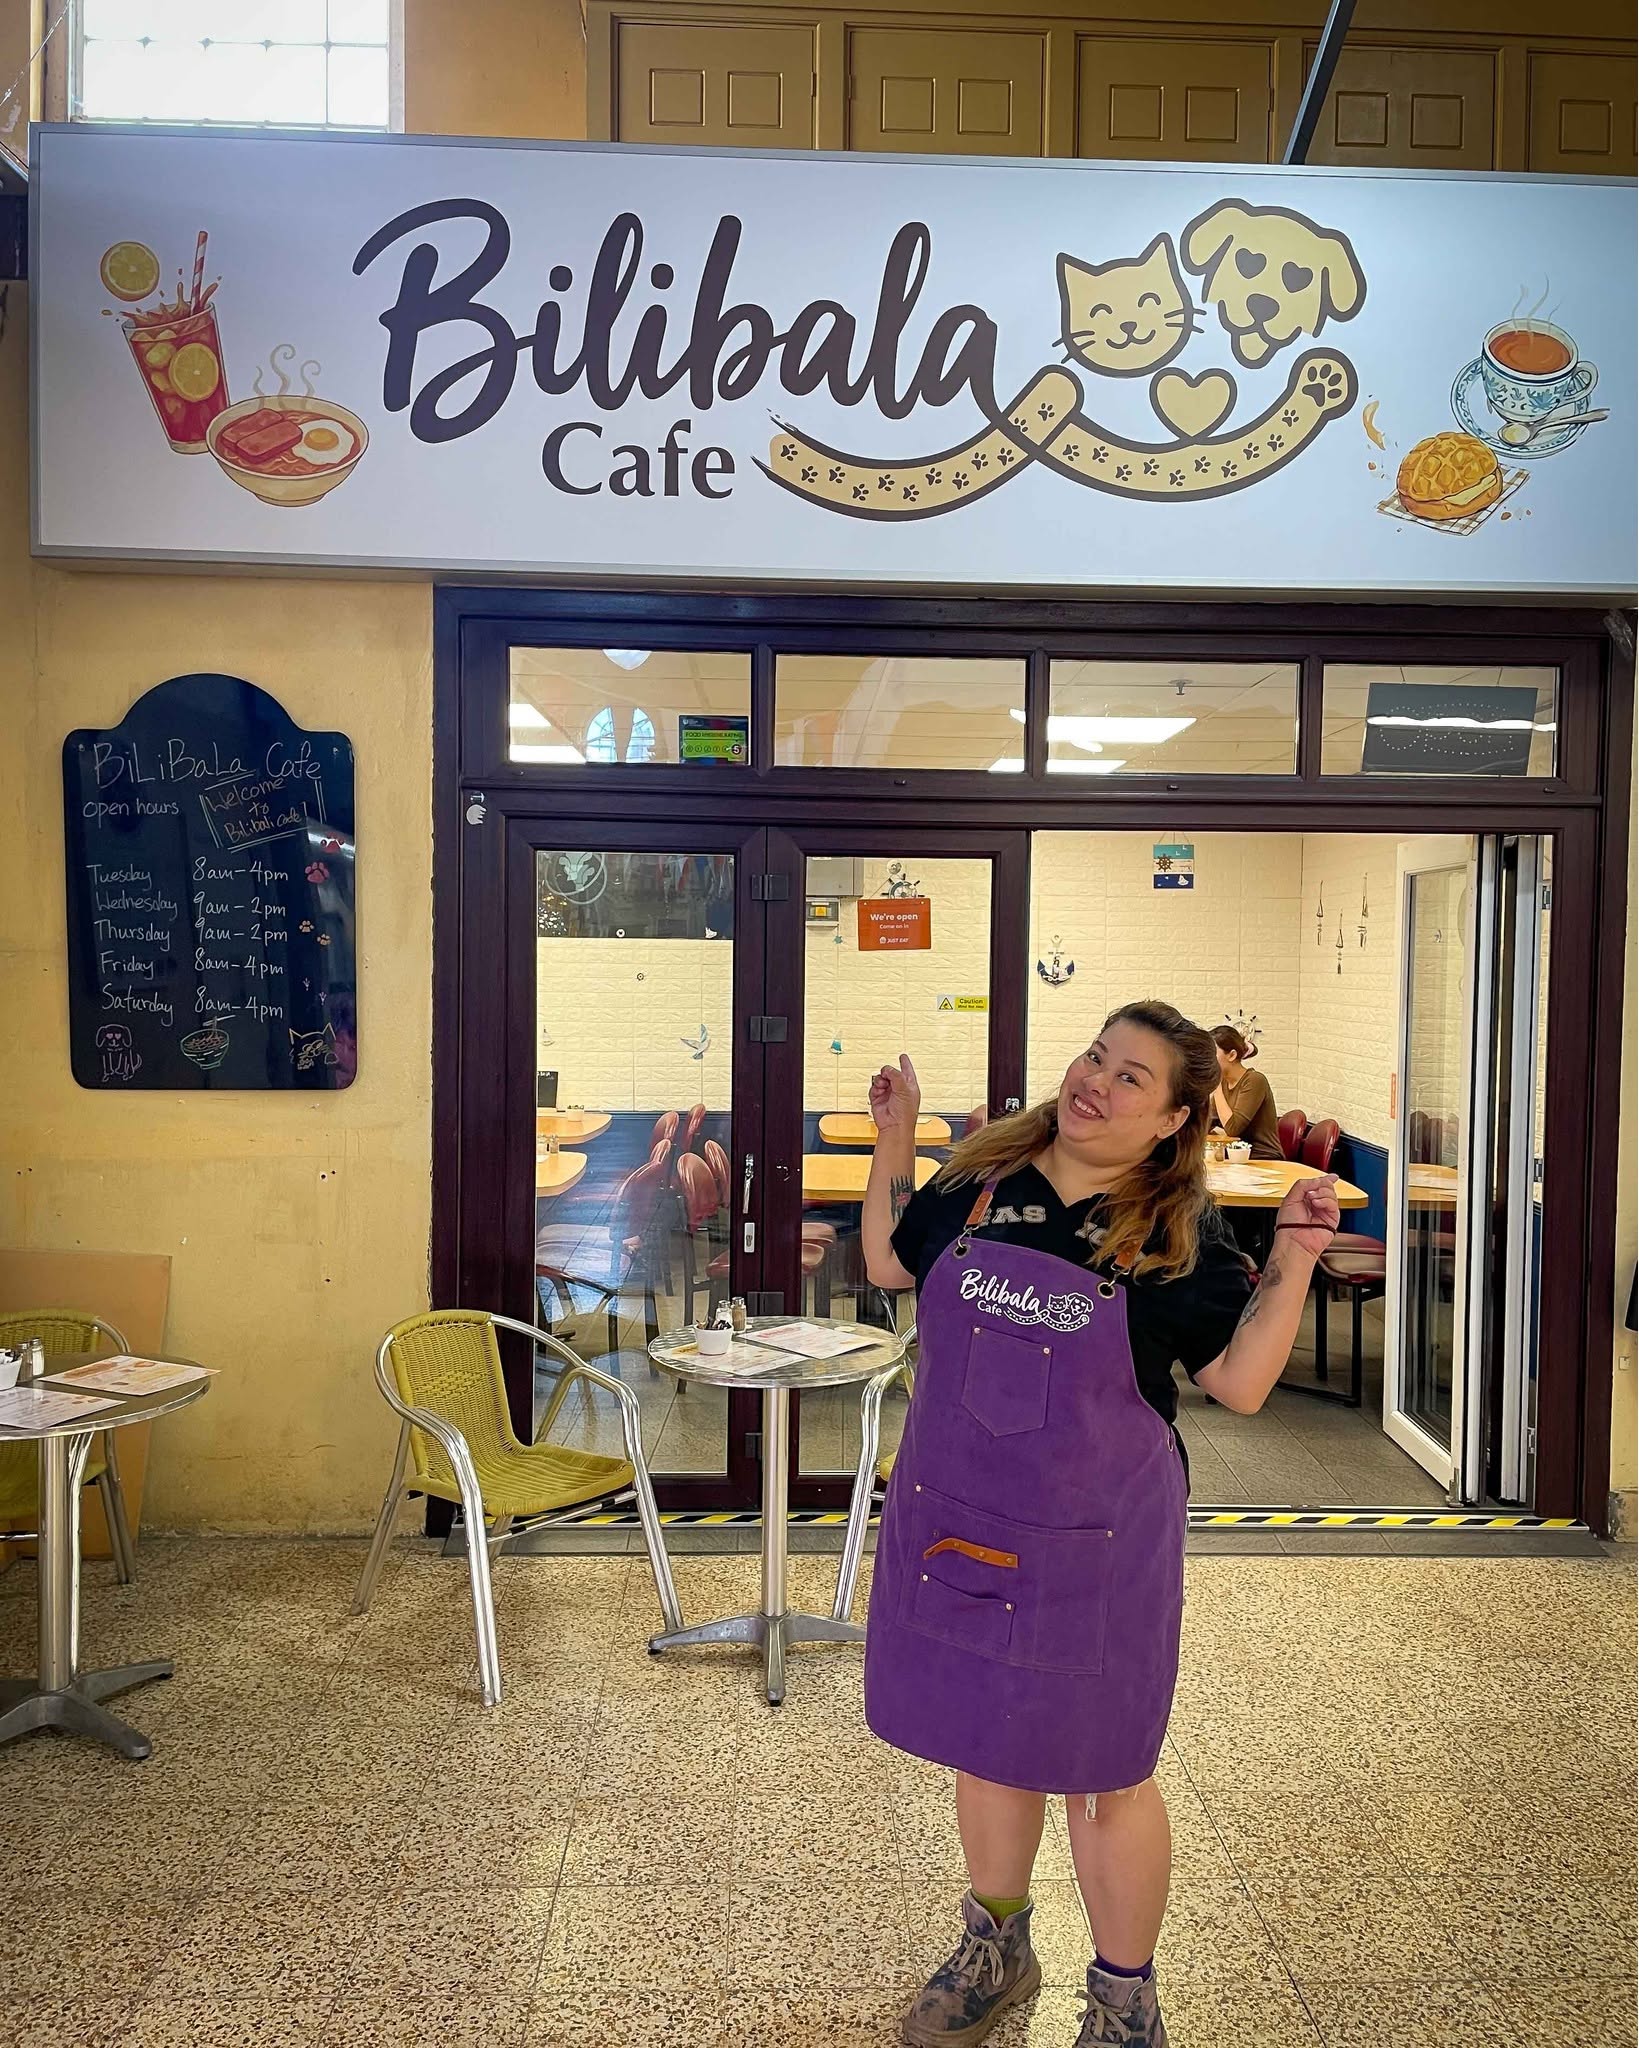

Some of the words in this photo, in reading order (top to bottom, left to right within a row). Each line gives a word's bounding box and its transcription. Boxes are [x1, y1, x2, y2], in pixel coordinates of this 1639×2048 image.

[351, 198, 1002, 443] Bilibala
[541, 419, 736, 499] Cafe
[265, 740, 322, 779] Cafe
[136, 798, 180, 816] hours
[205, 778, 287, 812] Welcome
[248, 801, 270, 817] to
[86, 863, 153, 891] Tuesday
[95, 889, 179, 921] Wednesday
[870, 913, 895, 921] We're
[897, 914, 918, 922] open
[93, 919, 170, 952] Thursday
[99, 950, 155, 980] Friday
[101, 983, 175, 1027] Saturday
[959, 1268, 1041, 1314] Bilibala
[976, 1299, 1003, 1317] Cafe
